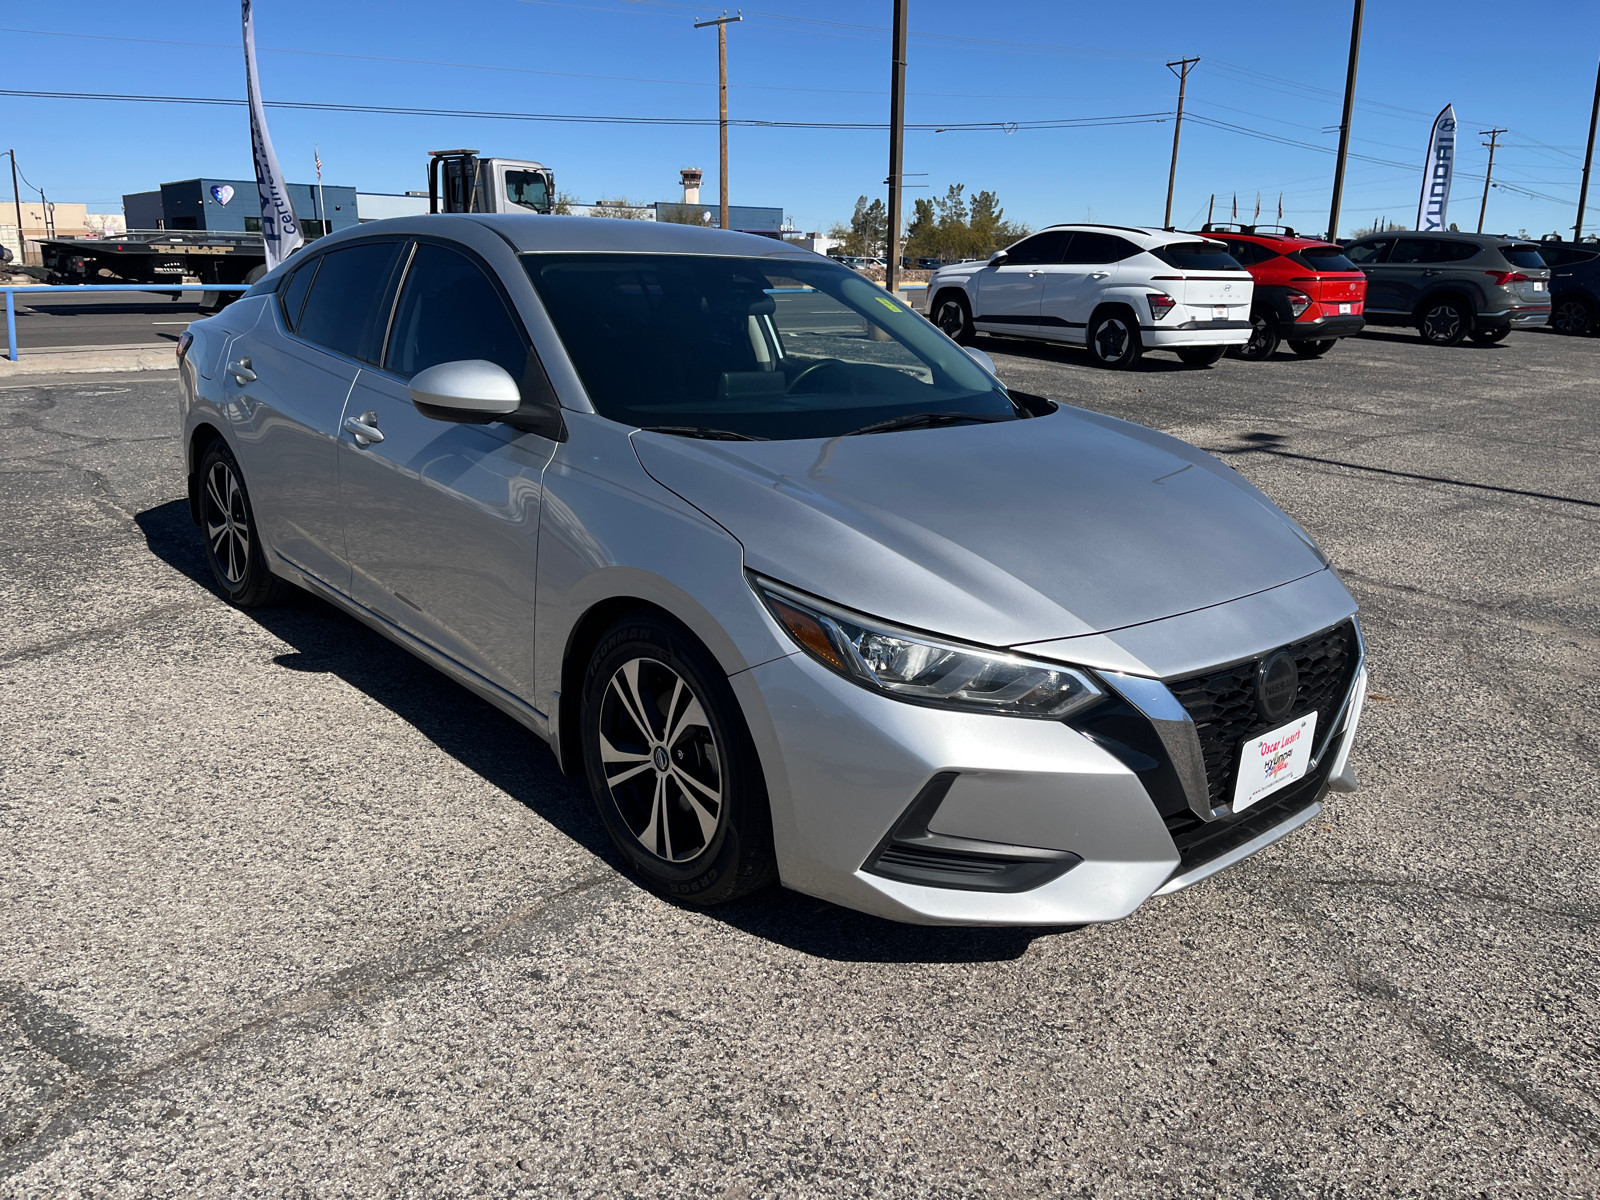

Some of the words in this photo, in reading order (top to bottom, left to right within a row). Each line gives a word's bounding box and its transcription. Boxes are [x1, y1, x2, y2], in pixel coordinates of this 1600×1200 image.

[1425, 138, 1454, 231] YUNDAI
[590, 628, 652, 677] IRONMAN
[1265, 676, 1296, 697] NISSAN
[1260, 740, 1280, 757] Oscar
[669, 868, 718, 893] GR906
